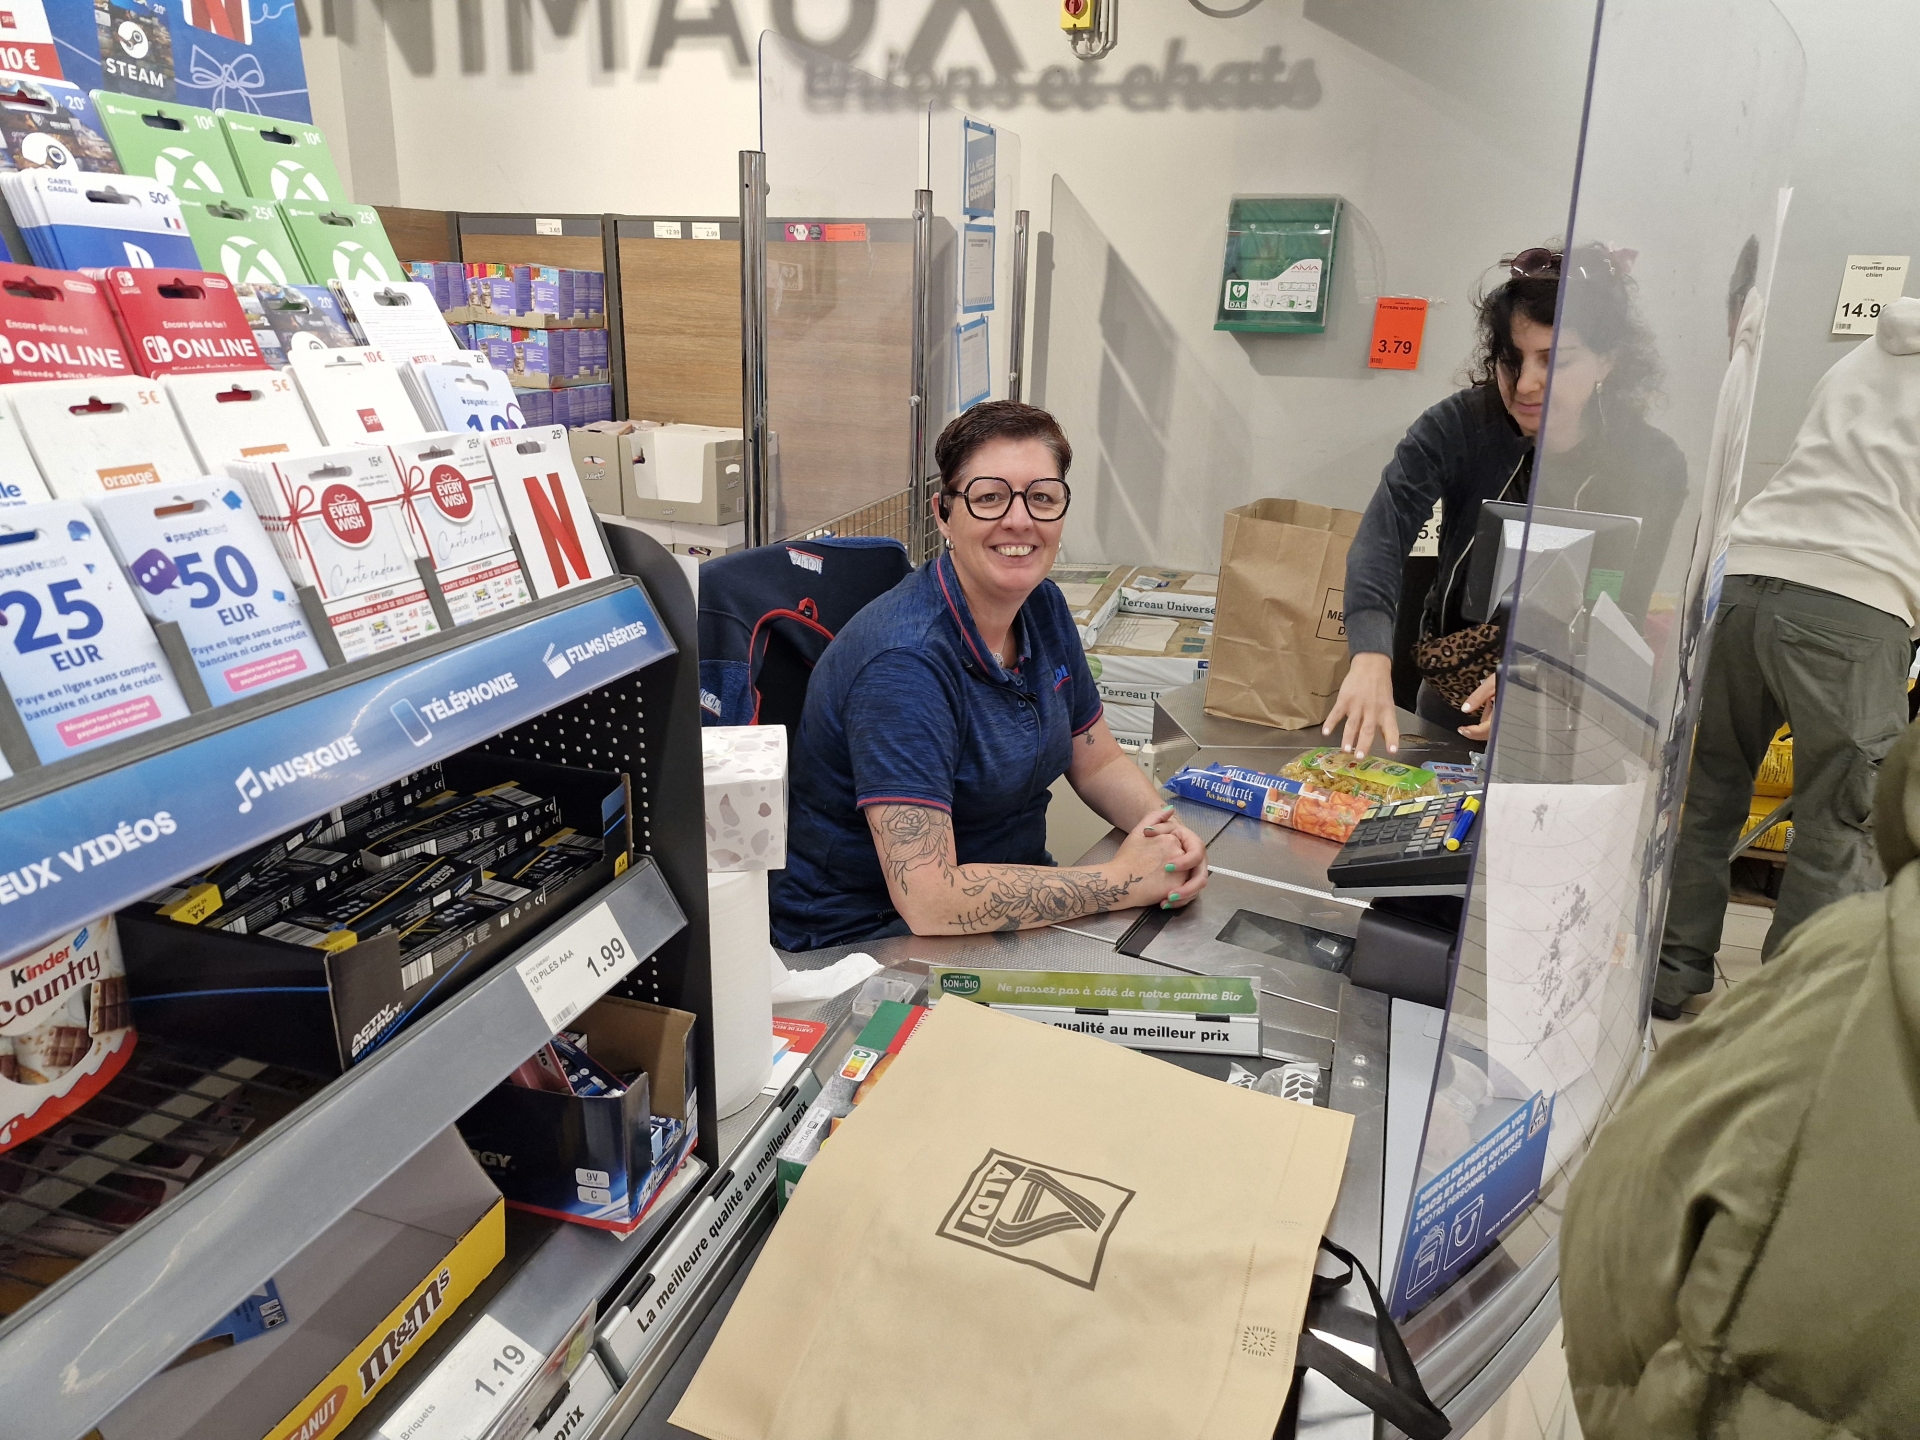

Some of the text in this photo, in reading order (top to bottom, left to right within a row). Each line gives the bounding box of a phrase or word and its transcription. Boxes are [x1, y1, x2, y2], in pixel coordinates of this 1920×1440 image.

[2, 15, 14, 23] SFR
[1, 48, 40, 70] 10€
[106, 58, 164, 88] STEAM
[194, 115, 215, 129] 10€
[302, 131, 322, 145] 10€
[47, 186, 78, 194] CADEAU
[48, 178, 72, 186] CARTE
[149, 191, 171, 204] 50€
[252, 206, 275, 220] 25€
[357, 211, 376, 225] 25€
[665, 228, 680, 236] 12.99
[1841, 302, 1887, 318] 14.9
[5, 319, 37, 330] Encore
[39, 323, 56, 334] plus
[70, 326, 83, 334] fun
[162, 320, 213, 330] Encore plus de
[16, 340, 125, 369] ONLINE
[172, 338, 257, 358] ONLINE
[1377, 339, 1413, 354] 3.79
[363, 351, 385, 363] 10€
[412, 355, 437, 365] NETFLIX
[364, 415, 380, 426] SFR
[467, 438, 481, 449] 25€
[489, 436, 512, 448] NETFLIX
[552, 428, 564, 441] 25€
[368, 456, 382, 467] 15€
[103, 471, 154, 490] orange
[584, 469, 605, 480] Juliet
[436, 481, 463, 496] EVERY
[329, 502, 361, 518] EVERY
[441, 493, 468, 508] WISH
[334, 515, 366, 531] WISH
[523, 472, 592, 589] N
[173, 525, 227, 543] paysafecard
[438, 520, 497, 561] Carte cadeau
[173, 545, 258, 609] 50
[330, 553, 402, 596] Carte cadeau
[445, 572, 488, 591] CARTE CADEAU PLUS
[217, 602, 259, 627] EUR
[336, 614, 353, 623] CARTE
[354, 607, 373, 619] CADEAU
[377, 603, 389, 612] PLUS
[1122, 597, 1216, 615] Terreau Universe
[0, 579, 103, 655] 25
[191, 619, 302, 656] Paye en ligne sans compte
[567, 621, 647, 662] FILMS/SÉRIES
[51, 644, 103, 672] EUR
[198, 629, 308, 668] bancaire ni carte de crédit
[15, 660, 157, 708] Paye en ligne sans compte
[1101, 686, 1147, 699] Terreau
[24, 673, 163, 721] bancaire ni carte de crédit
[421, 672, 518, 724] TÉLÉPHONIE
[259, 735, 362, 792] MUSIQUE
[1191, 776, 1253, 802] PÂTE FEUILLETÉE
[1226, 768, 1290, 791] PÂTE FEUILLETÉE
[0, 811, 177, 905] EUX VIDÉOS
[617, 858, 626, 868] AA
[431, 867, 456, 889] ACTIV
[187, 903, 200, 914] PACK
[191, 905, 206, 920] AA
[10, 946, 70, 989] Kinder
[587, 937, 625, 978] 1.99
[530, 950, 575, 986] 10 PILES AAA
[0, 950, 100, 1028] Country
[943, 979, 978, 988] BON BIO
[997, 982, 1243, 1003] Ne passez pas à côté de notre gamme Bio
[351, 1001, 403, 1058] ENERGY
[352, 1003, 390, 1048] ACTIV
[376, 1010, 406, 1042] ALKALINE
[1053, 1020, 1230, 1043] qualité au meilleur prix
[1419, 1109, 1527, 1205] MERCI DE PRÉSENTER VOS
[586, 1172, 598, 1182] 9V
[1416, 1125, 1525, 1220] SACS ET CABAS OUVERTS
[1420, 1139, 1522, 1229] NOTRE PERSONNEL DE CAISSE
[590, 1190, 598, 1199] C
[962, 1163, 1016, 1230] ALDI
[636, 1308, 656, 1333] La
[656, 1237, 708, 1310] meilleure
[709, 1189, 743, 1238] qualité
[743, 1173, 757, 1191] au
[757, 1128, 792, 1174] meilleur
[791, 1100, 810, 1128] prix
[475, 1344, 525, 1397] 1.19
[400, 1403, 436, 1440] Briquets
[553, 1405, 585, 1440] prix
